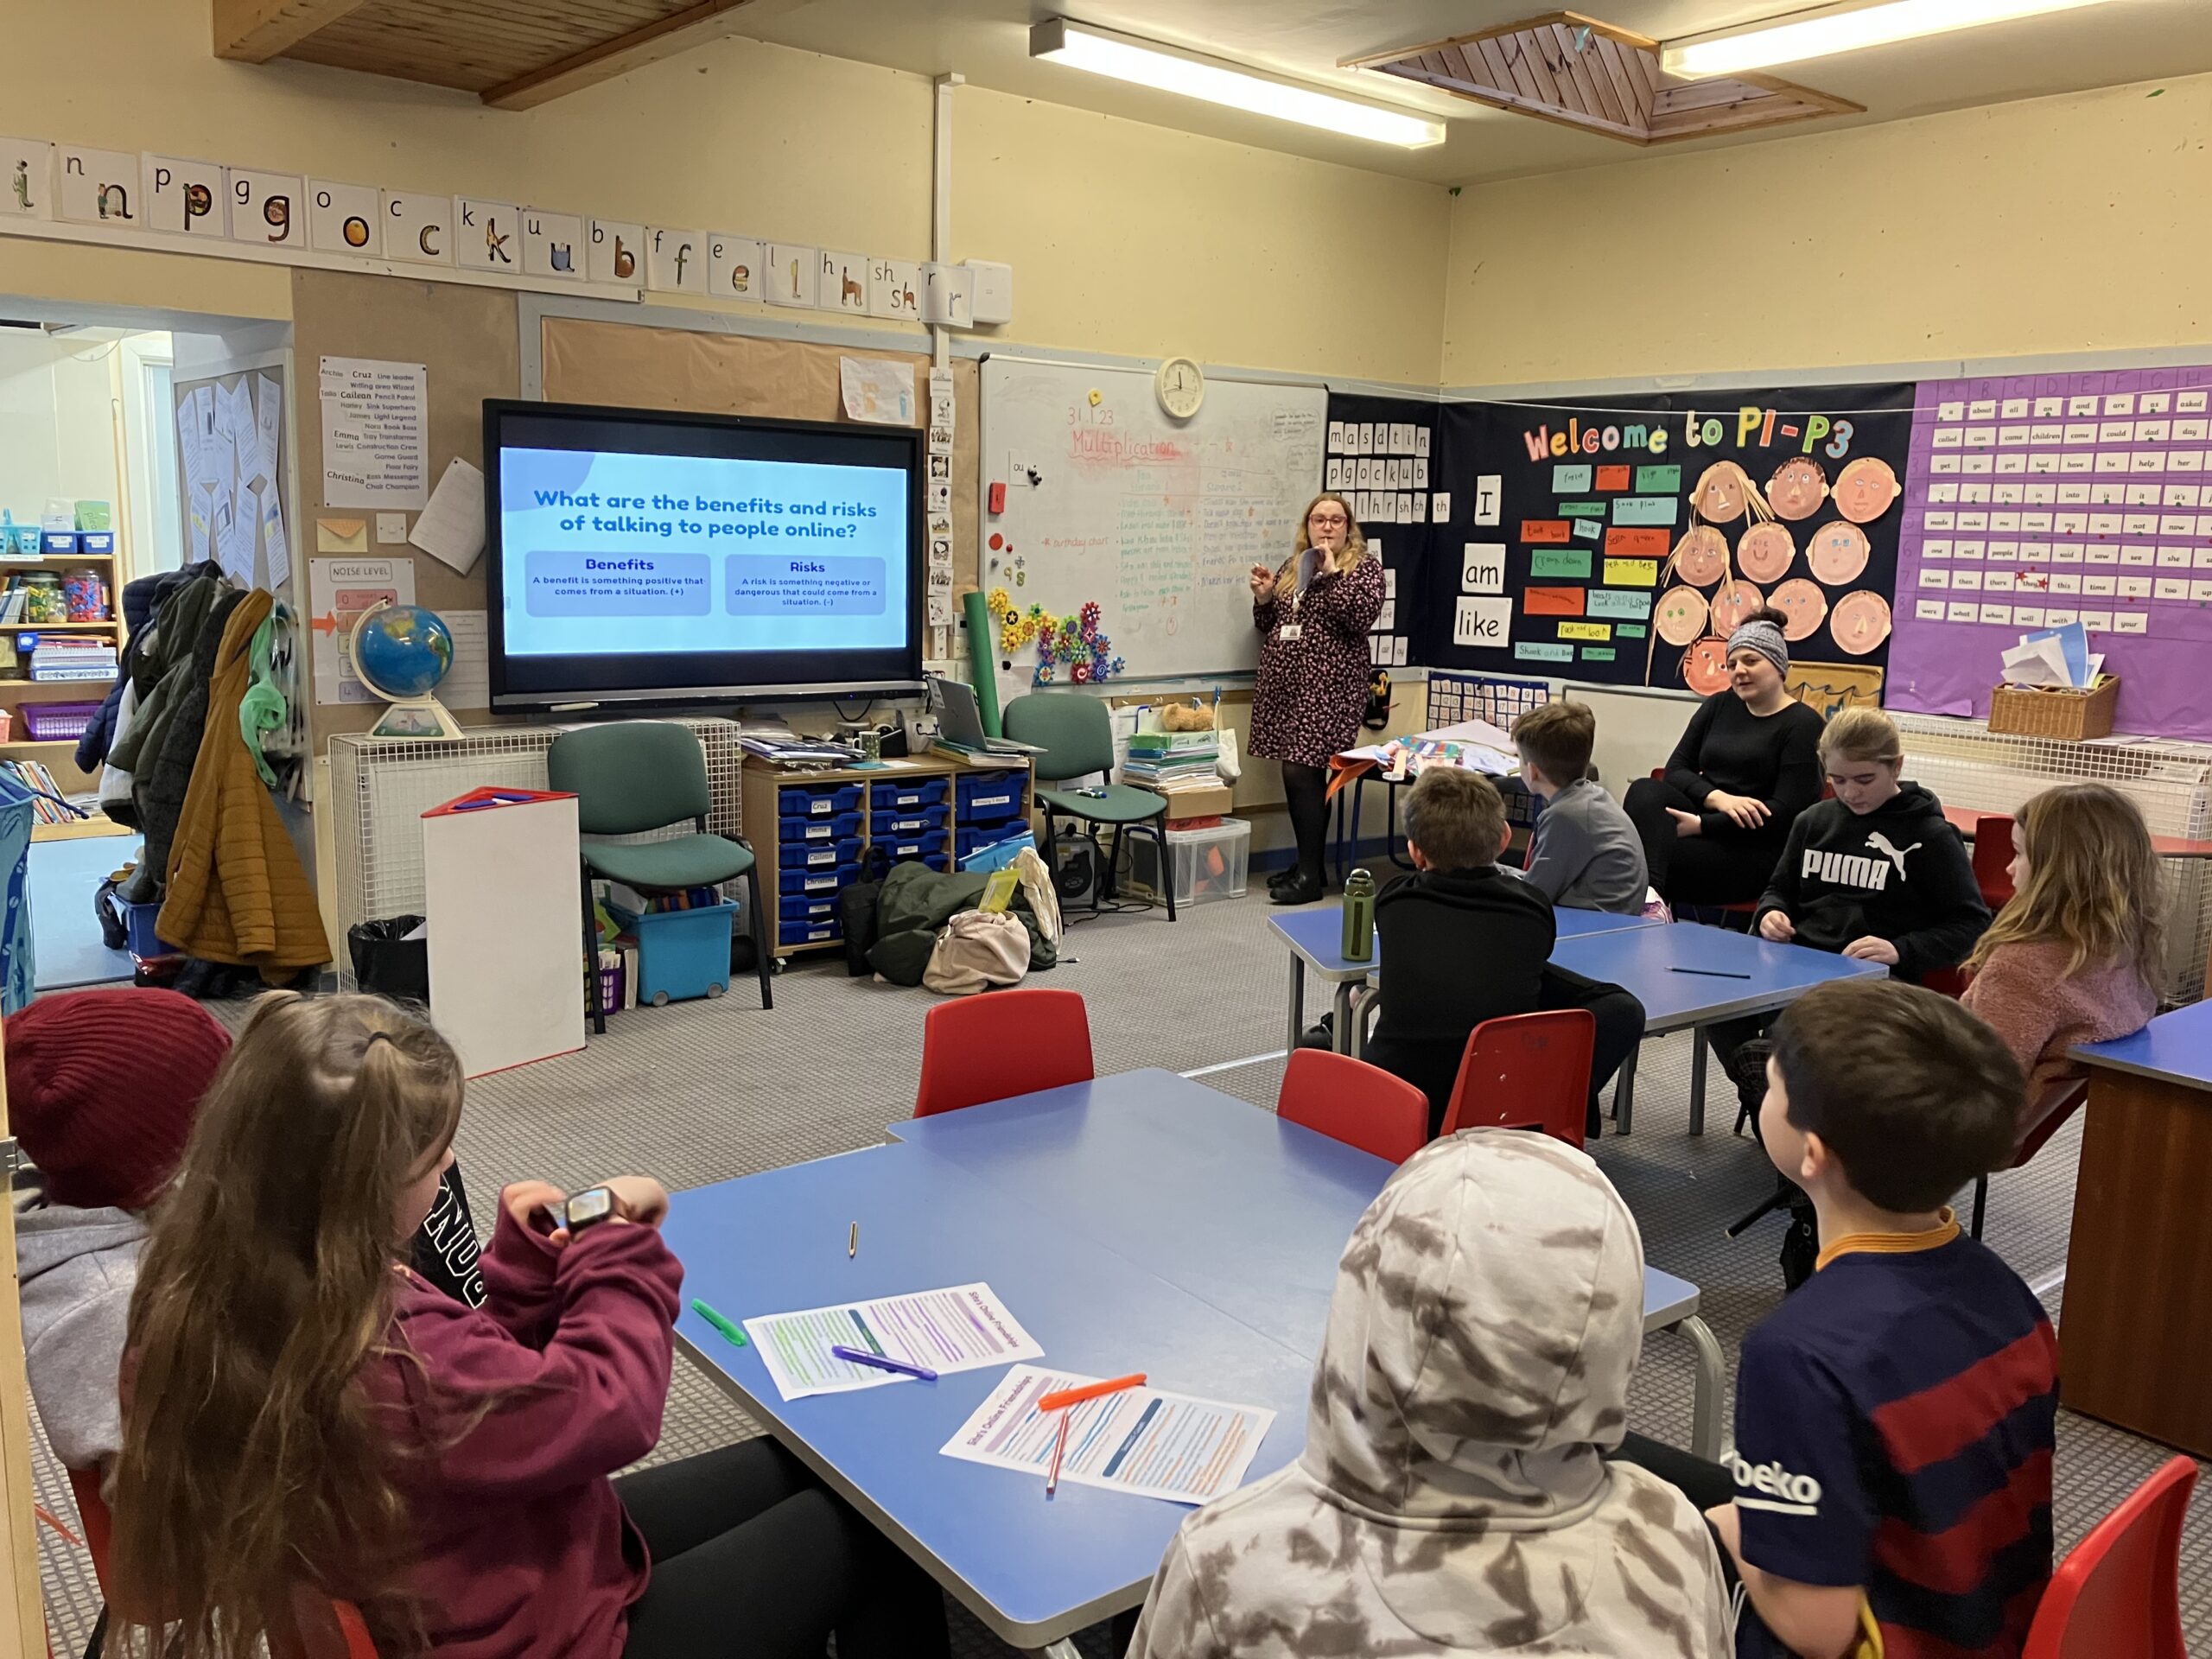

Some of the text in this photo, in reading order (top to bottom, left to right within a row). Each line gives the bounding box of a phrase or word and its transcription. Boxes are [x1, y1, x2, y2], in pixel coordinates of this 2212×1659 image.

[67, 156, 85, 175] n
[156, 167, 171, 193] p
[236, 180, 251, 205] g
[317, 191, 332, 208] o
[390, 200, 403, 217] c
[462, 203, 474, 226] k
[264, 195, 290, 242] g
[528, 219, 542, 235] u
[592, 220, 604, 244] b
[654, 231, 664, 253] f
[713, 243, 723, 258] e
[823, 253, 834, 275] h
[874, 264, 894, 283] sh
[334, 430, 359, 441] Emma
[1524, 417, 1669, 462] Welcome
[1686, 410, 1724, 448] to
[2183, 428, 2197, 436] day
[1072, 429, 1176, 463] Multiplication
[1014, 463, 1025, 472] ou
[327, 471, 365, 485] Christina
[534, 490, 877, 518] What are the benefits and risks
[1479, 492, 1492, 516] I
[560, 515, 857, 539] of talking to people online?
[333, 567, 389, 576] NOISE LEVEL
[585, 558, 654, 570] Benefits
[790, 562, 825, 573] Risks
[592, 576, 643, 586] something
[645, 577, 683, 586] positive
[779, 578, 823, 587] something
[824, 579, 861, 588] negative
[1465, 563, 1498, 585] am
[734, 588, 780, 597] dangerous
[1459, 610, 1499, 637] like
[1802, 849, 1890, 891] PUMA
